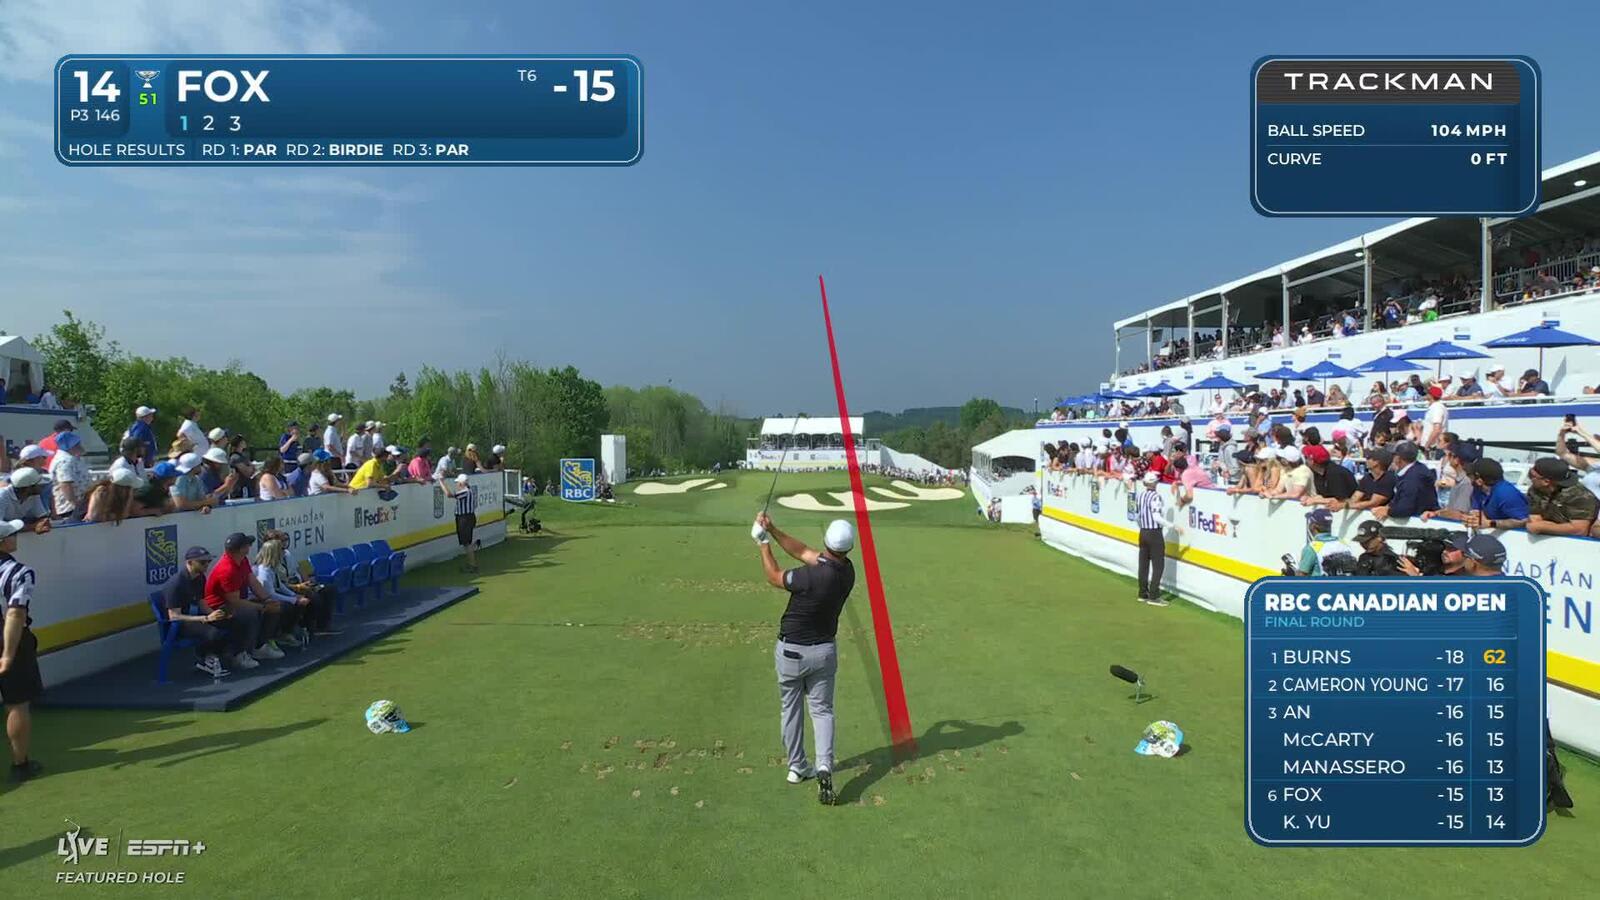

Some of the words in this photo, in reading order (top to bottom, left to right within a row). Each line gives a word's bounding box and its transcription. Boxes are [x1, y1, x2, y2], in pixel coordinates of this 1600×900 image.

[565, 488, 591, 499] RBC
[363, 507, 390, 527] FedEx
[1198, 511, 1228, 536] FedEx
[150, 564, 179, 582] RBC
